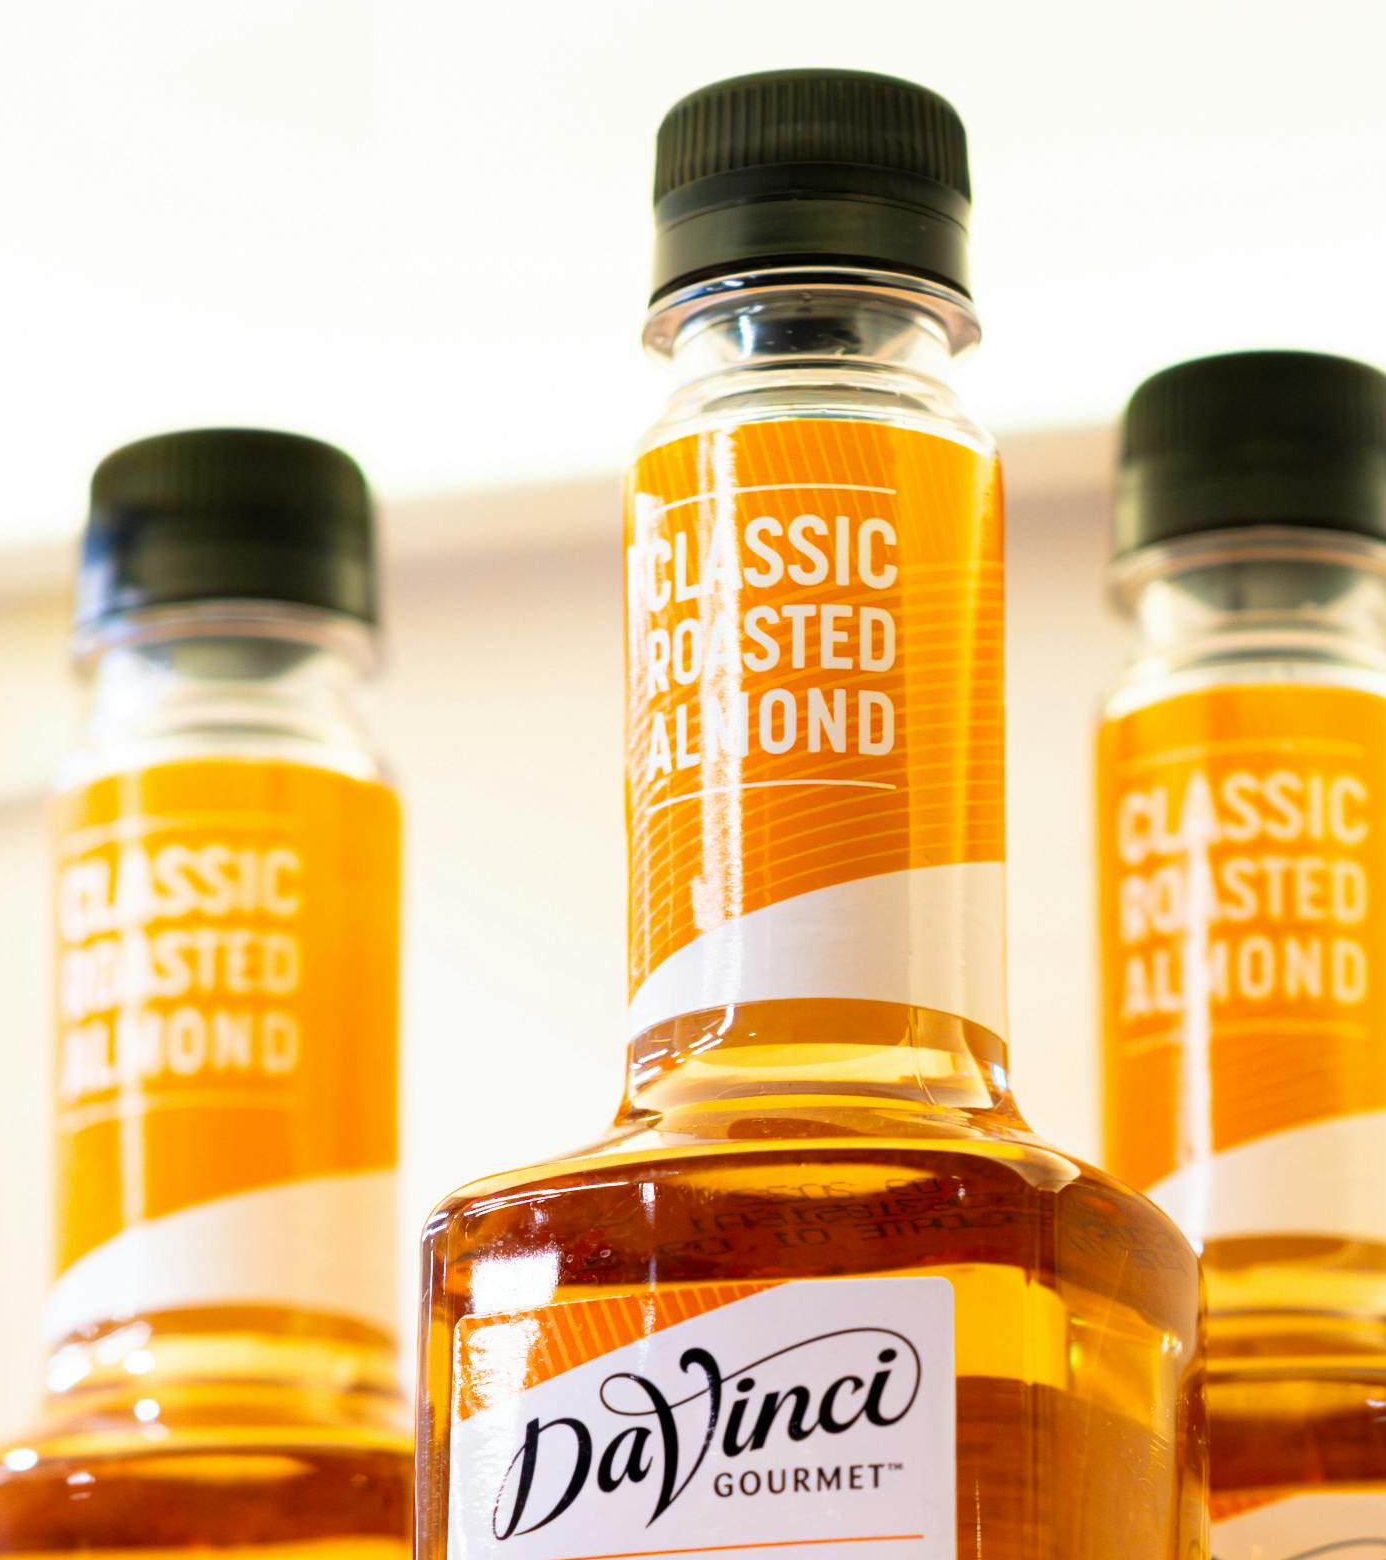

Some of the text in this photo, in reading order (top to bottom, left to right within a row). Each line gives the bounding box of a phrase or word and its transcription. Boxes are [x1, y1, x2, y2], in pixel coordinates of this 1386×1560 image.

[646, 515, 898, 611] CLASSIC
[647, 604, 896, 700] ROASTED
[646, 688, 895, 783] ALMOND
[1117, 770, 1367, 865] CLASSIC
[1118, 857, 1367, 944] ROASTED
[493, 1327, 921, 1540] DaVinci
